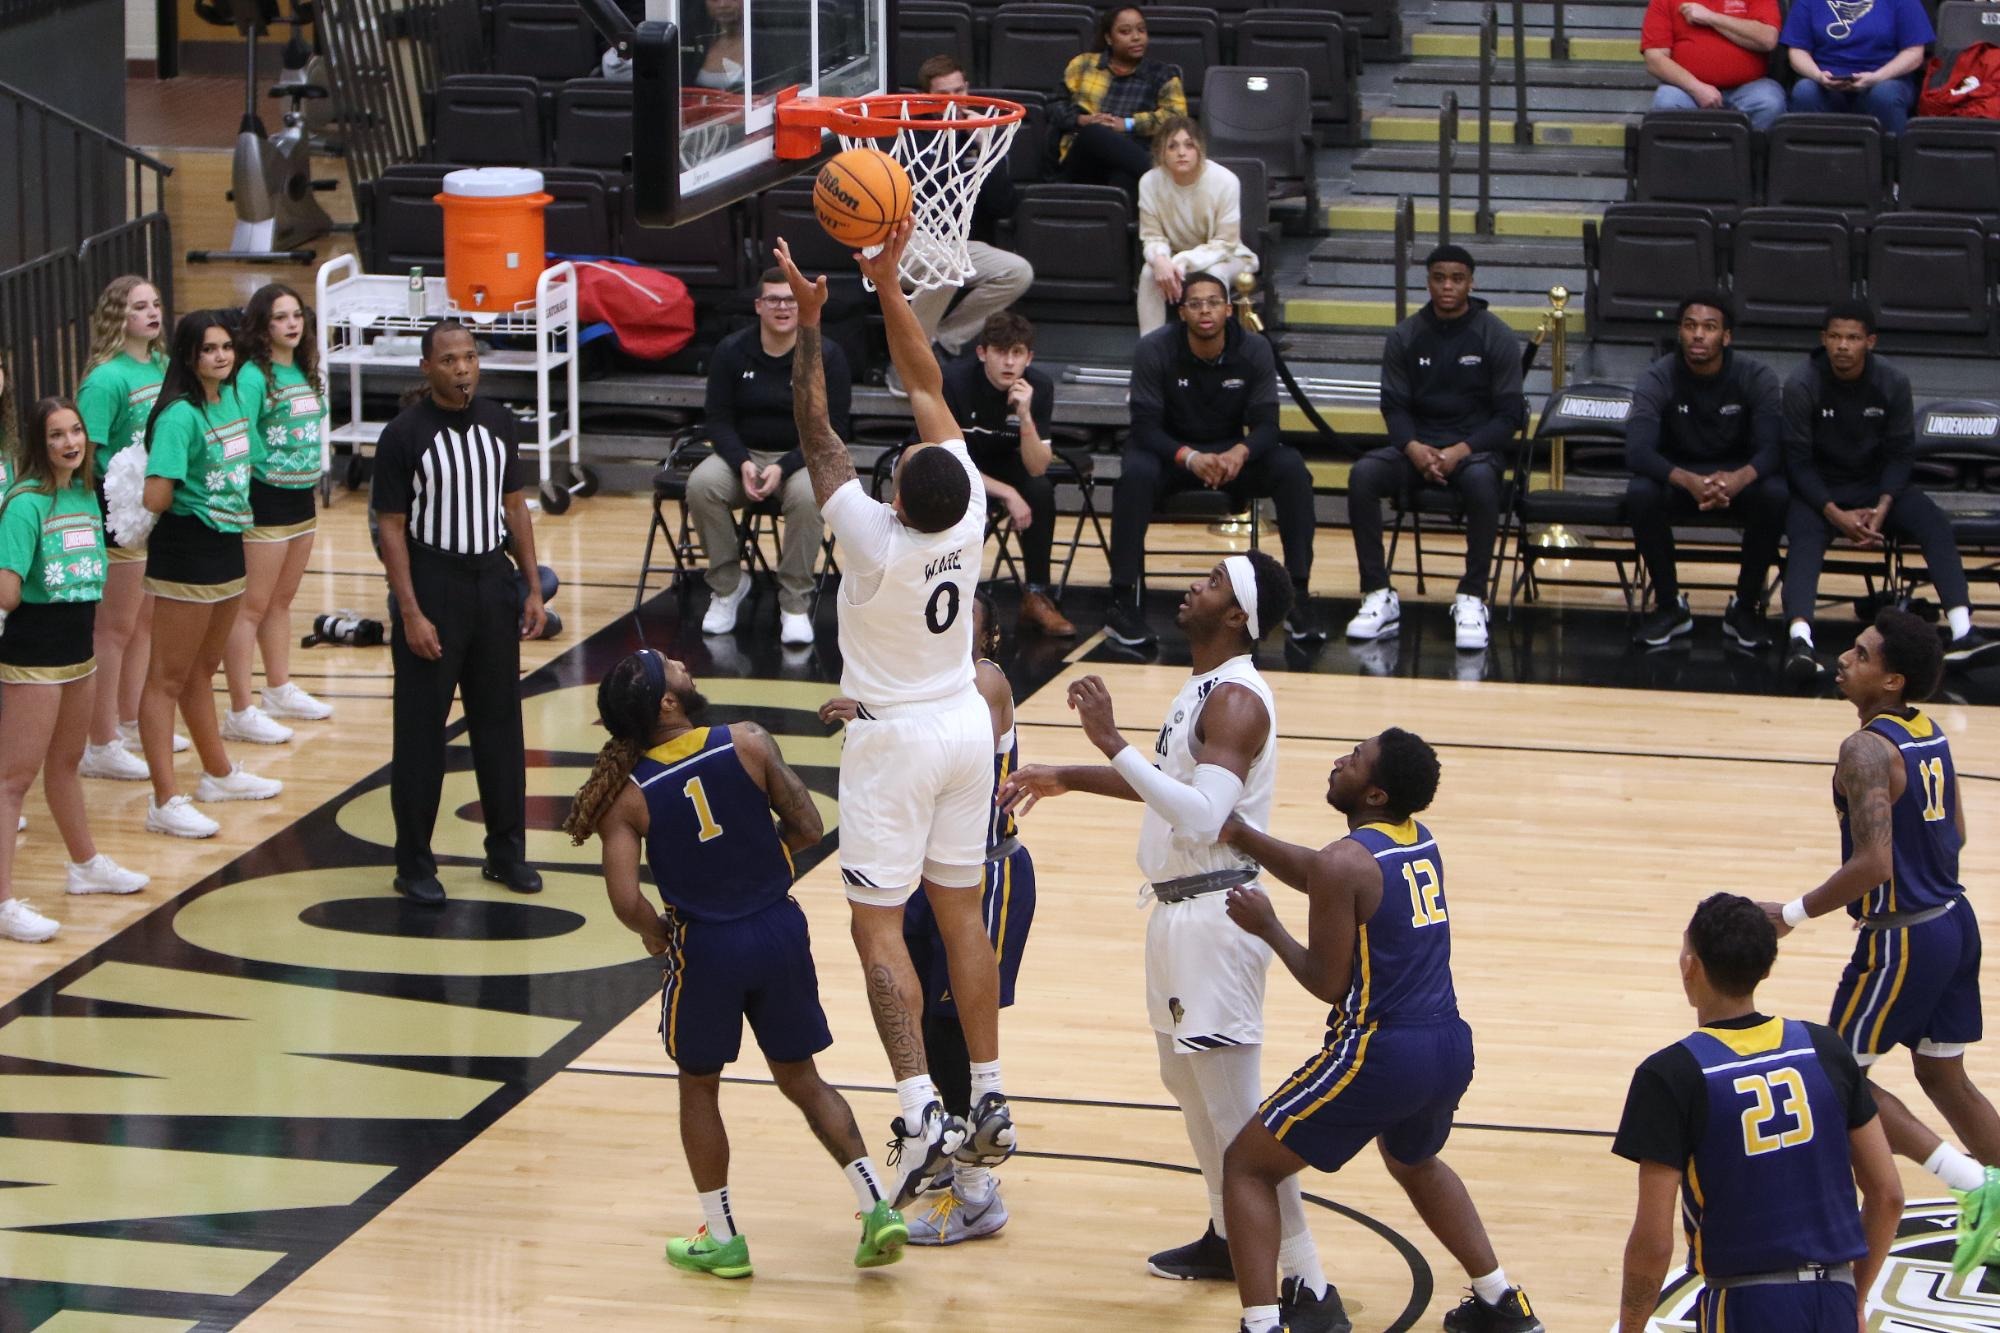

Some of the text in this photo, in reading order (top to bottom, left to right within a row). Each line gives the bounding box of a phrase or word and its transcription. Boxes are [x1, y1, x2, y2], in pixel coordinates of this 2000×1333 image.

[818, 167, 860, 210] Wilson
[1561, 397, 1631, 419] LINDENWOOD
[1927, 415, 1998, 435] LINDENWOOD
[924, 581, 960, 634] 0
[683, 776, 723, 842] 1
[1919, 757, 1945, 821] 11
[1402, 859, 1447, 928] 12
[1733, 1067, 1814, 1156] 23
